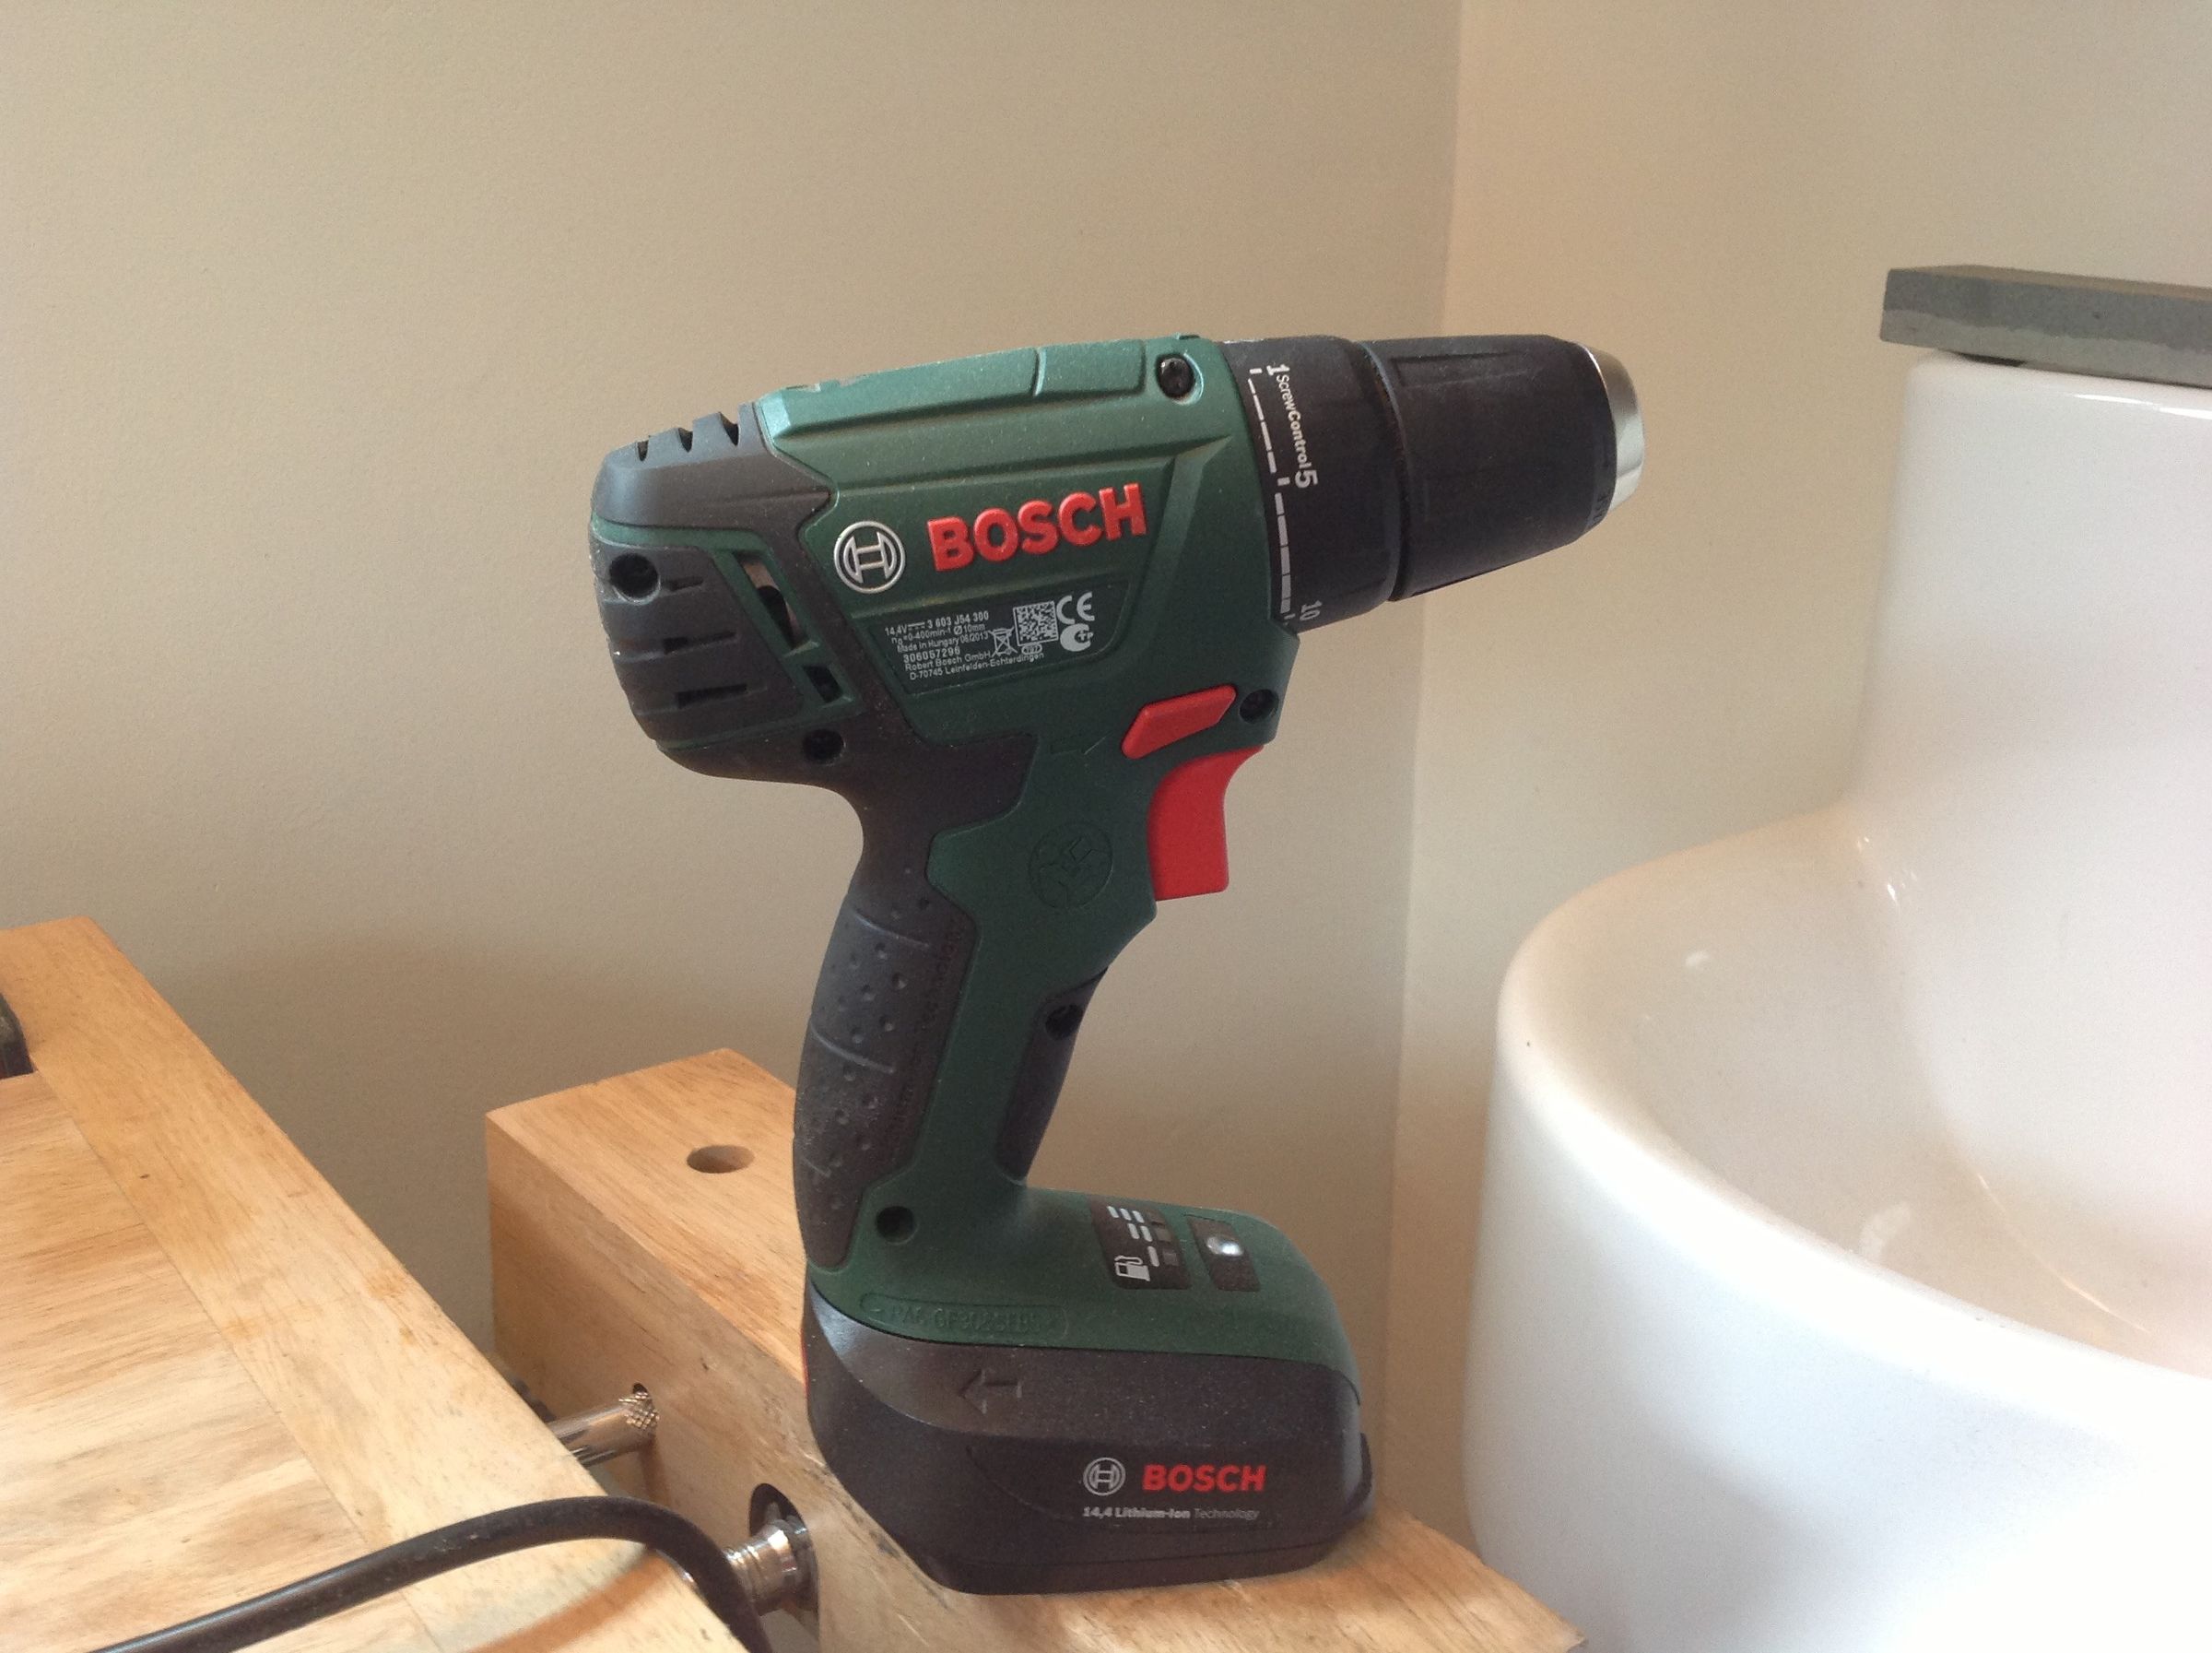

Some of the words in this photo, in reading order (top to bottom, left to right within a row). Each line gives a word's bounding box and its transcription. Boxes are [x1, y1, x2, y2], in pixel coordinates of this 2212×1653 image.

[1266, 364, 1290, 376] 1
[1277, 374, 1312, 469] ScrewControl
[1295, 469, 1319, 489] 5
[927, 482, 1147, 572] BOSCH
[935, 616, 952, 628] 603
[954, 613, 971, 626] J54
[972, 610, 990, 622] 300
[1300, 600, 1323, 621] 10
[897, 643, 918, 654] Made
[919, 641, 927, 649] in
[928, 637, 959, 649] Hungary
[905, 660, 934, 672] Robert
[935, 656, 962, 668] Bosch
[964, 650, 991, 663] GmbH
[910, 667, 944, 681] D-70745
[1142, 1464, 1266, 1492] BOSCH
[1194, 1507, 1260, 1520] Technology
